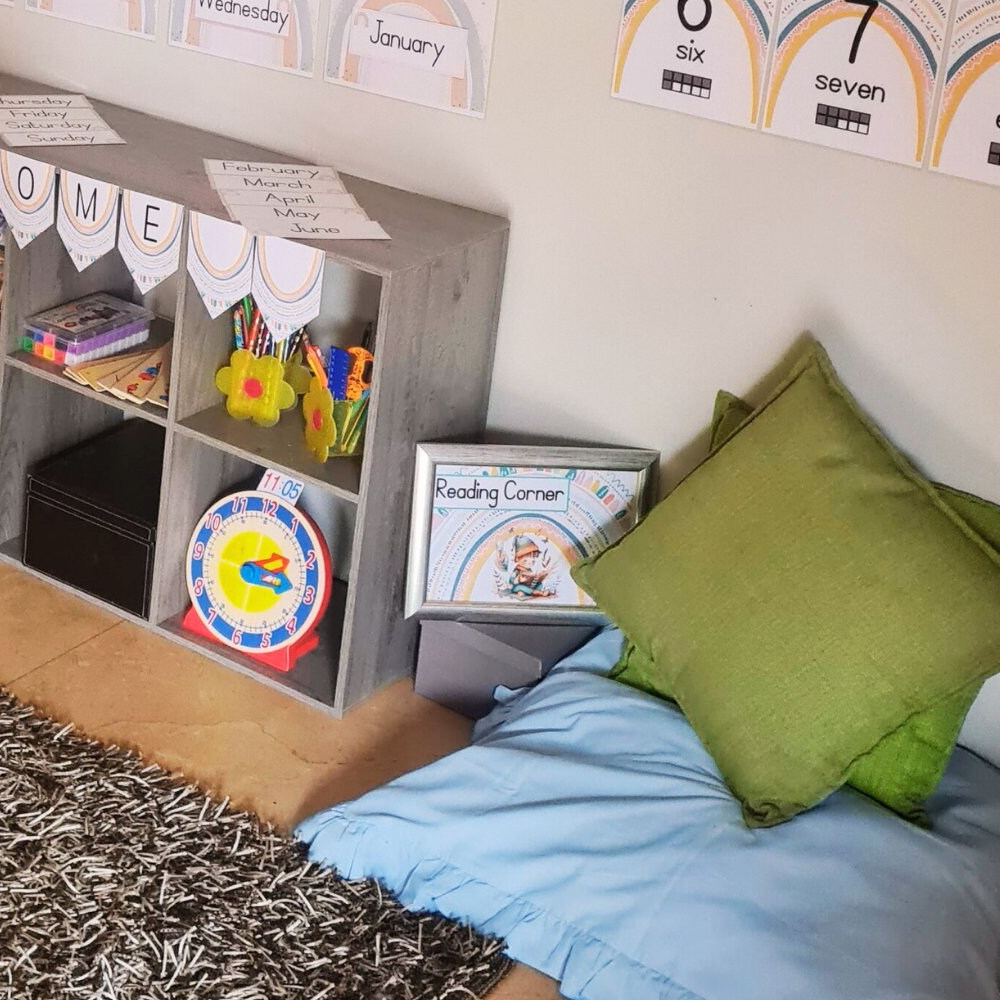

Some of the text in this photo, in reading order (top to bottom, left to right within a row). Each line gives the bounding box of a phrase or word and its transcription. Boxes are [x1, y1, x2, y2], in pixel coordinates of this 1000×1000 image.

[368, 19, 445, 68] January
[675, 39, 705, 64] six
[814, 73, 886, 104] seven
[9, 110, 68, 120] Friday
[6, 121, 92, 131] Saturday
[27, 134, 96, 144] Sunday
[222, 162, 319, 179] February
[243, 177, 312, 190] March
[265, 193, 316, 206] April
[273, 207, 320, 221] May
[290, 222, 340, 234] June
[263, 472, 302, 499] 11:05
[435, 478, 565, 508] Reading Corner
[232, 496, 248, 514] 11
[262, 498, 280, 517] 12
[205, 513, 222, 531] 10
[291, 518, 299, 534] 1
[193, 543, 204, 560] 9
[306, 550, 316, 569] 2
[194, 579, 204, 596] 8
[304, 587, 314, 604] 3
[207, 609, 218, 626] 7
[286, 617, 296, 635] 4
[231, 628, 242, 646] 6
[260, 631, 271, 649] 5
